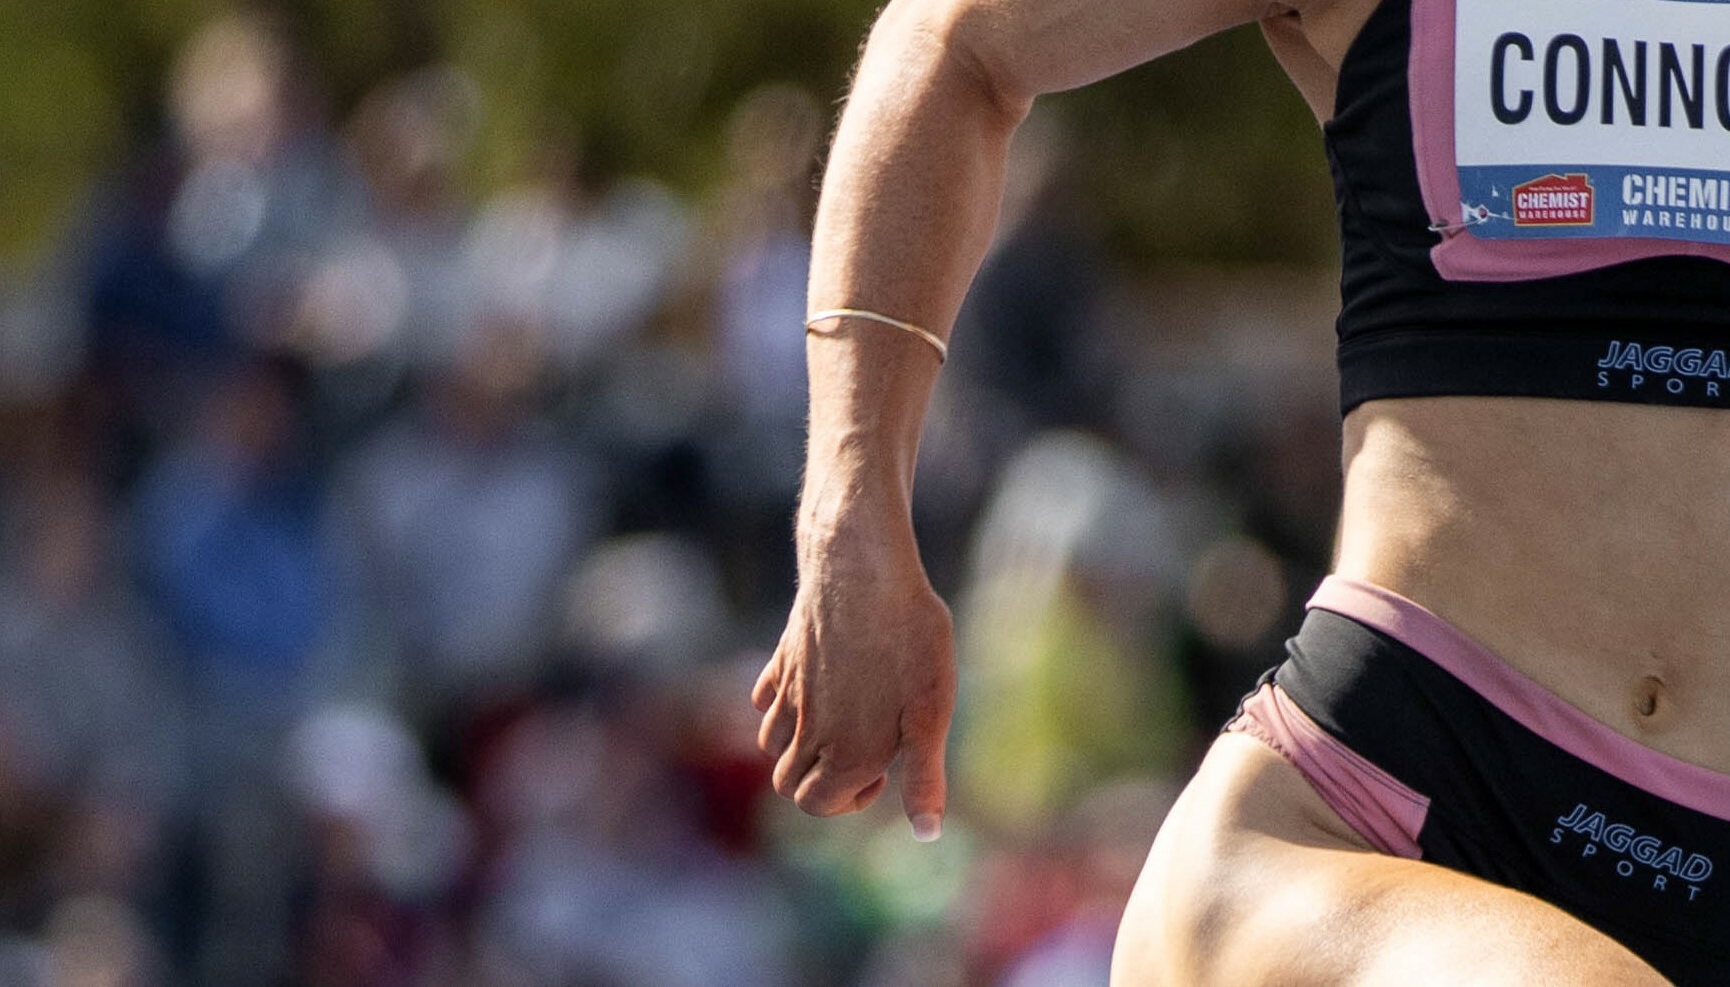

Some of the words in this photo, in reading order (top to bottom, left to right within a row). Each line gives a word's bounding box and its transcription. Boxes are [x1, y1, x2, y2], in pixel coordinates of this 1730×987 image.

[1517, 192, 1589, 210] CHEMIST
[1518, 209, 1588, 220] WAREHOUSE
[1550, 828, 1700, 901] SPORT
[1558, 803, 1713, 882] JAGGAD
